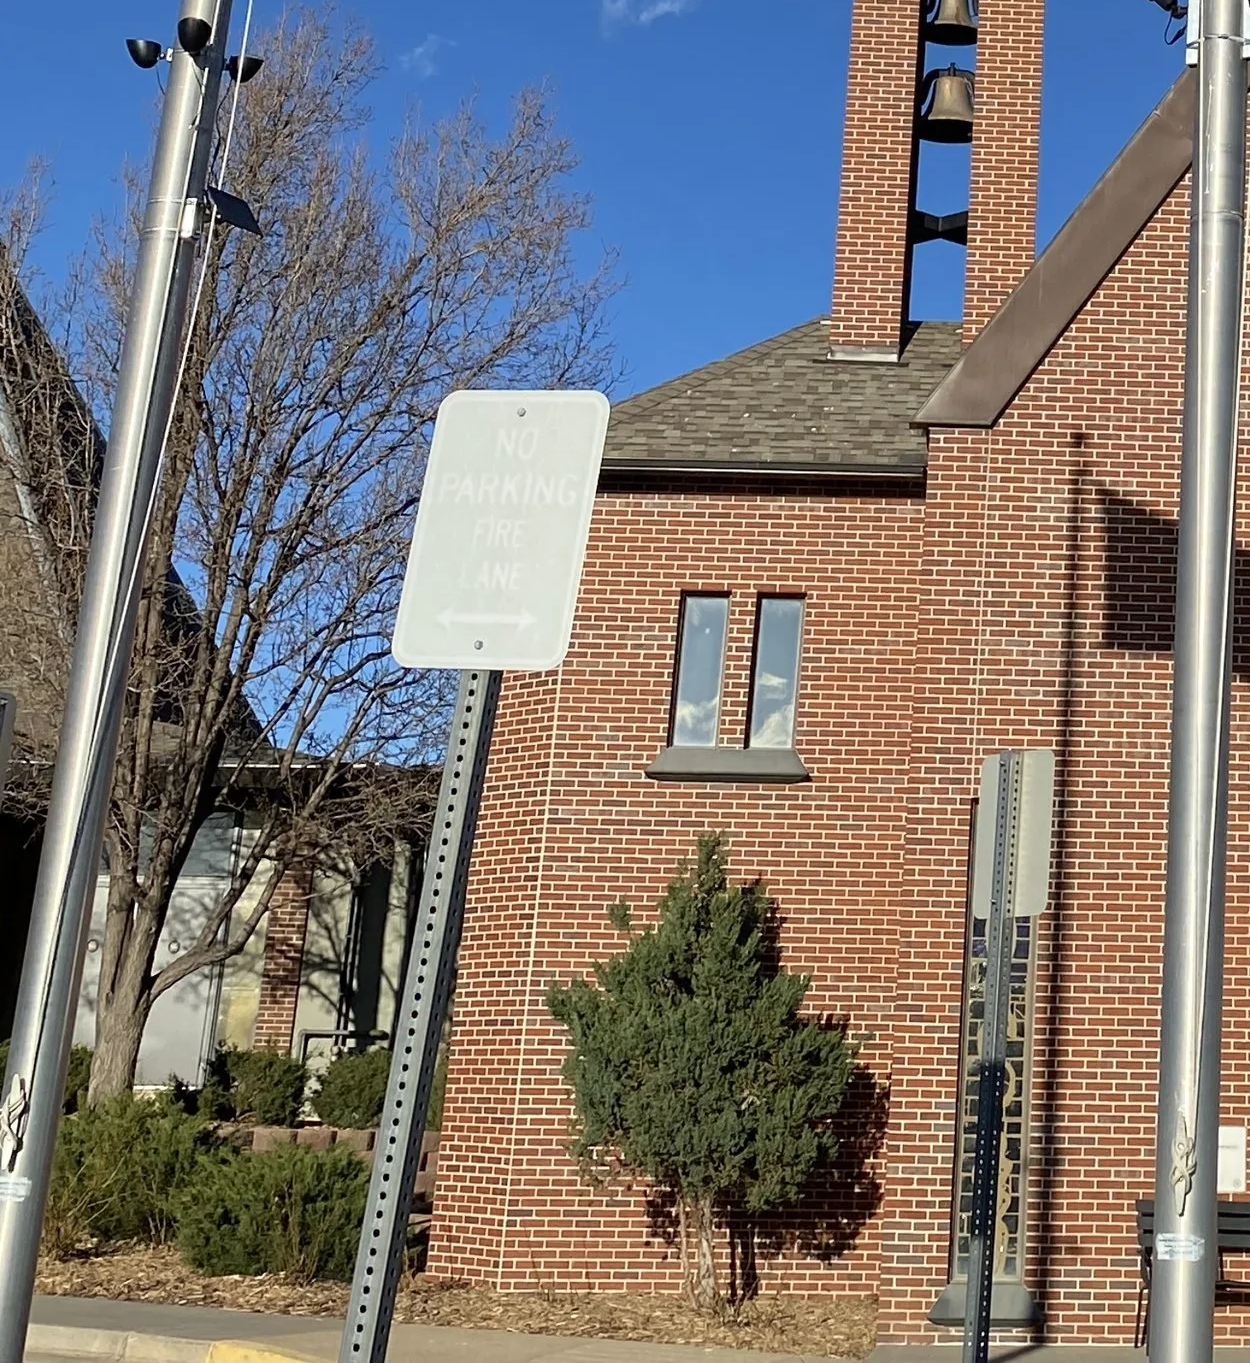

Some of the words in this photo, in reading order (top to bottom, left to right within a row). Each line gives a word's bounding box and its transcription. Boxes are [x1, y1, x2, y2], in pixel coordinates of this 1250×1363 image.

[494, 426, 540, 461] NO
[437, 471, 580, 508] PARKING
[472, 517, 529, 550] FIRE
